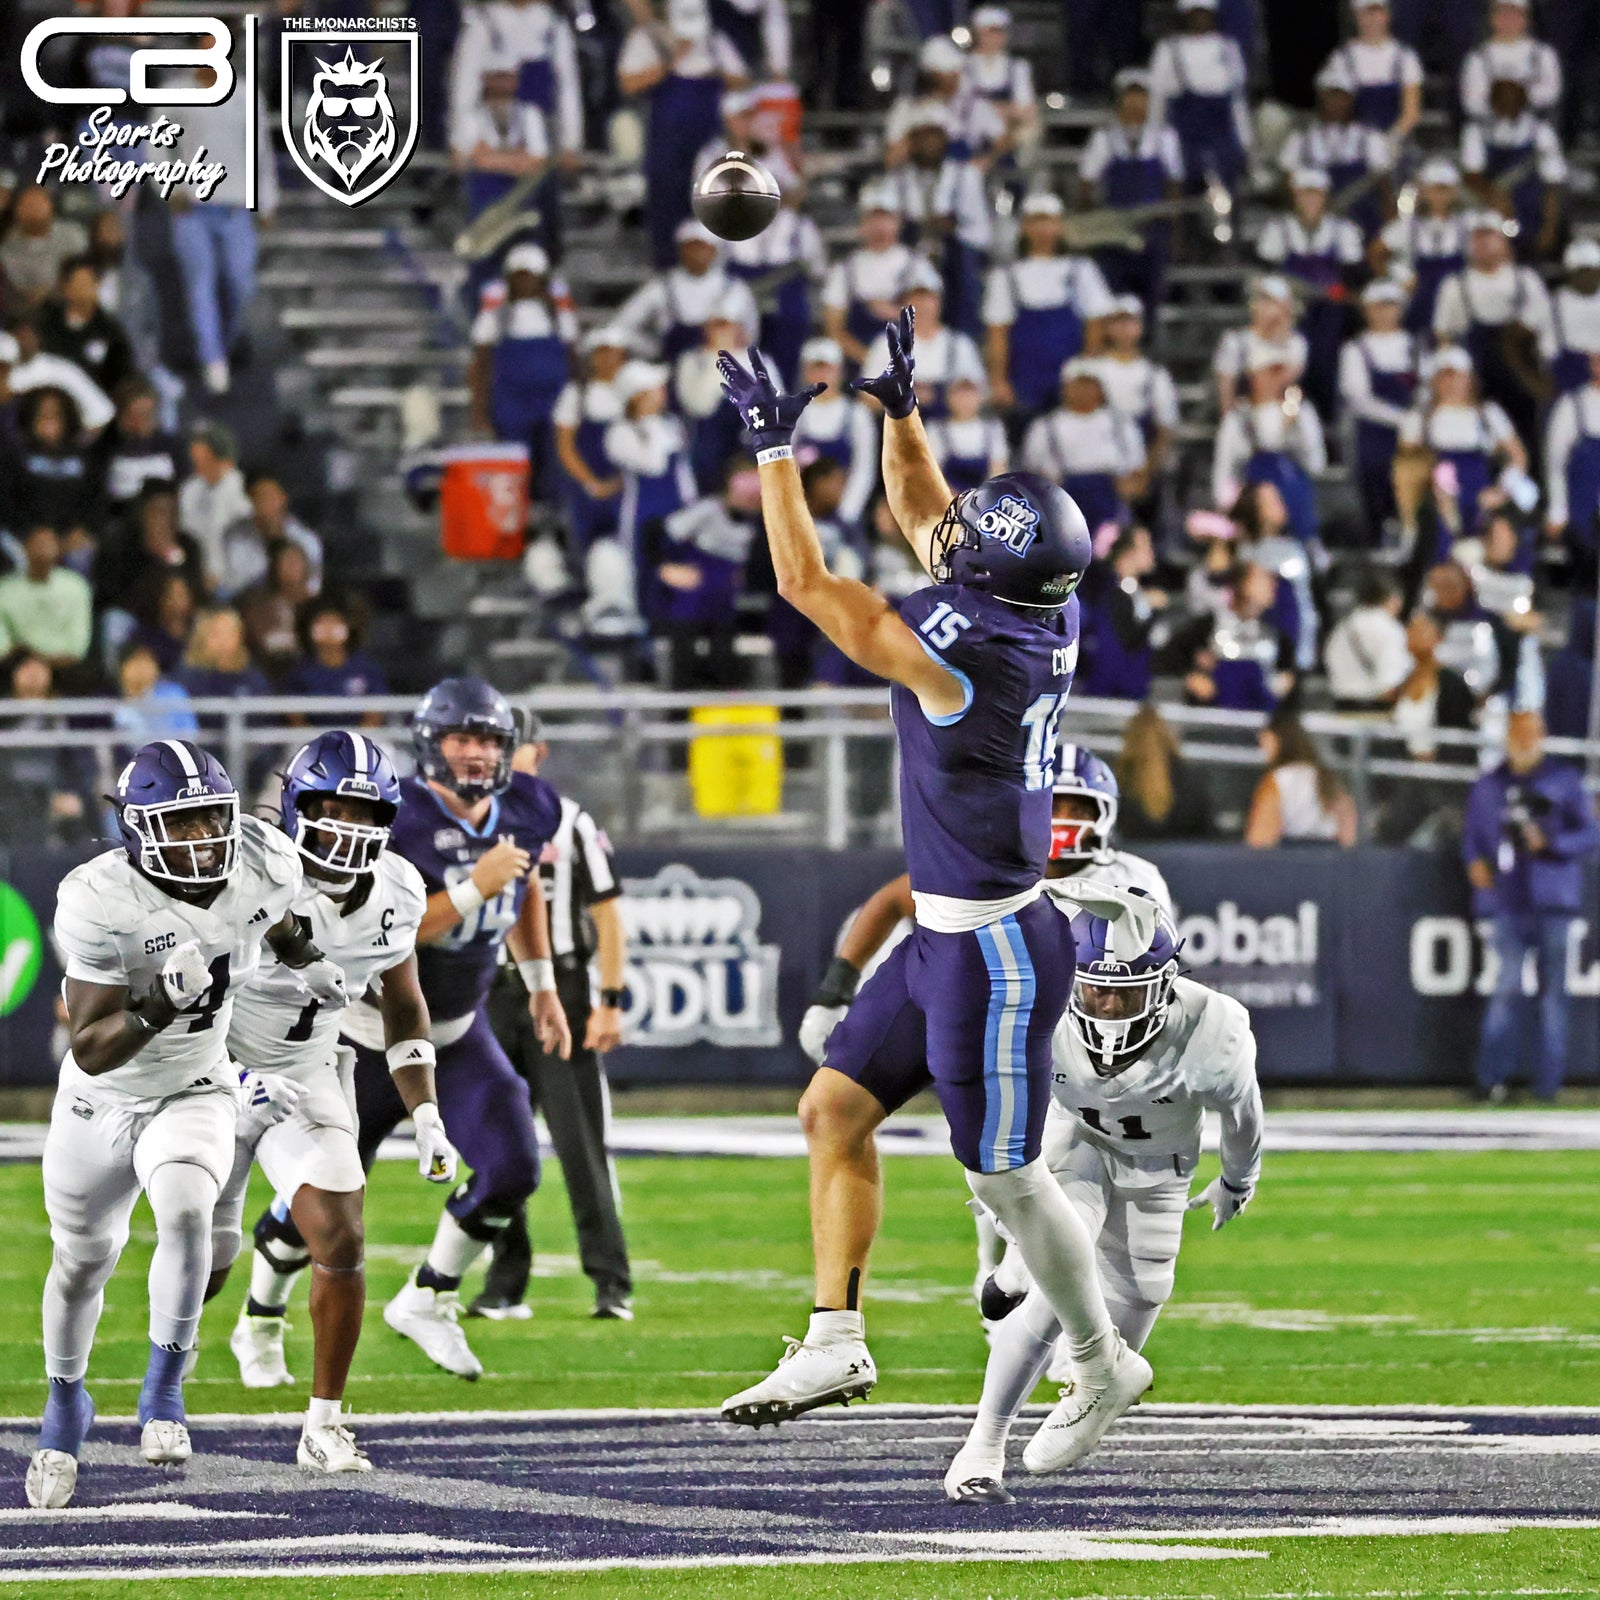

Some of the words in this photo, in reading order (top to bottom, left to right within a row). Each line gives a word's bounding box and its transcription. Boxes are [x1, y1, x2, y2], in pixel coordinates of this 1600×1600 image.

[977, 510, 1032, 553] ODU
[919, 601, 972, 650] 15
[117, 761, 136, 796] 4
[187, 787, 209, 796] GATA
[381, 908, 394, 931] C
[1175, 899, 1319, 966] obal
[144, 932, 176, 955] SBC
[1098, 963, 1121, 973] GATA
[180, 952, 231, 1034] 4
[1077, 1107, 1152, 1140] 11
